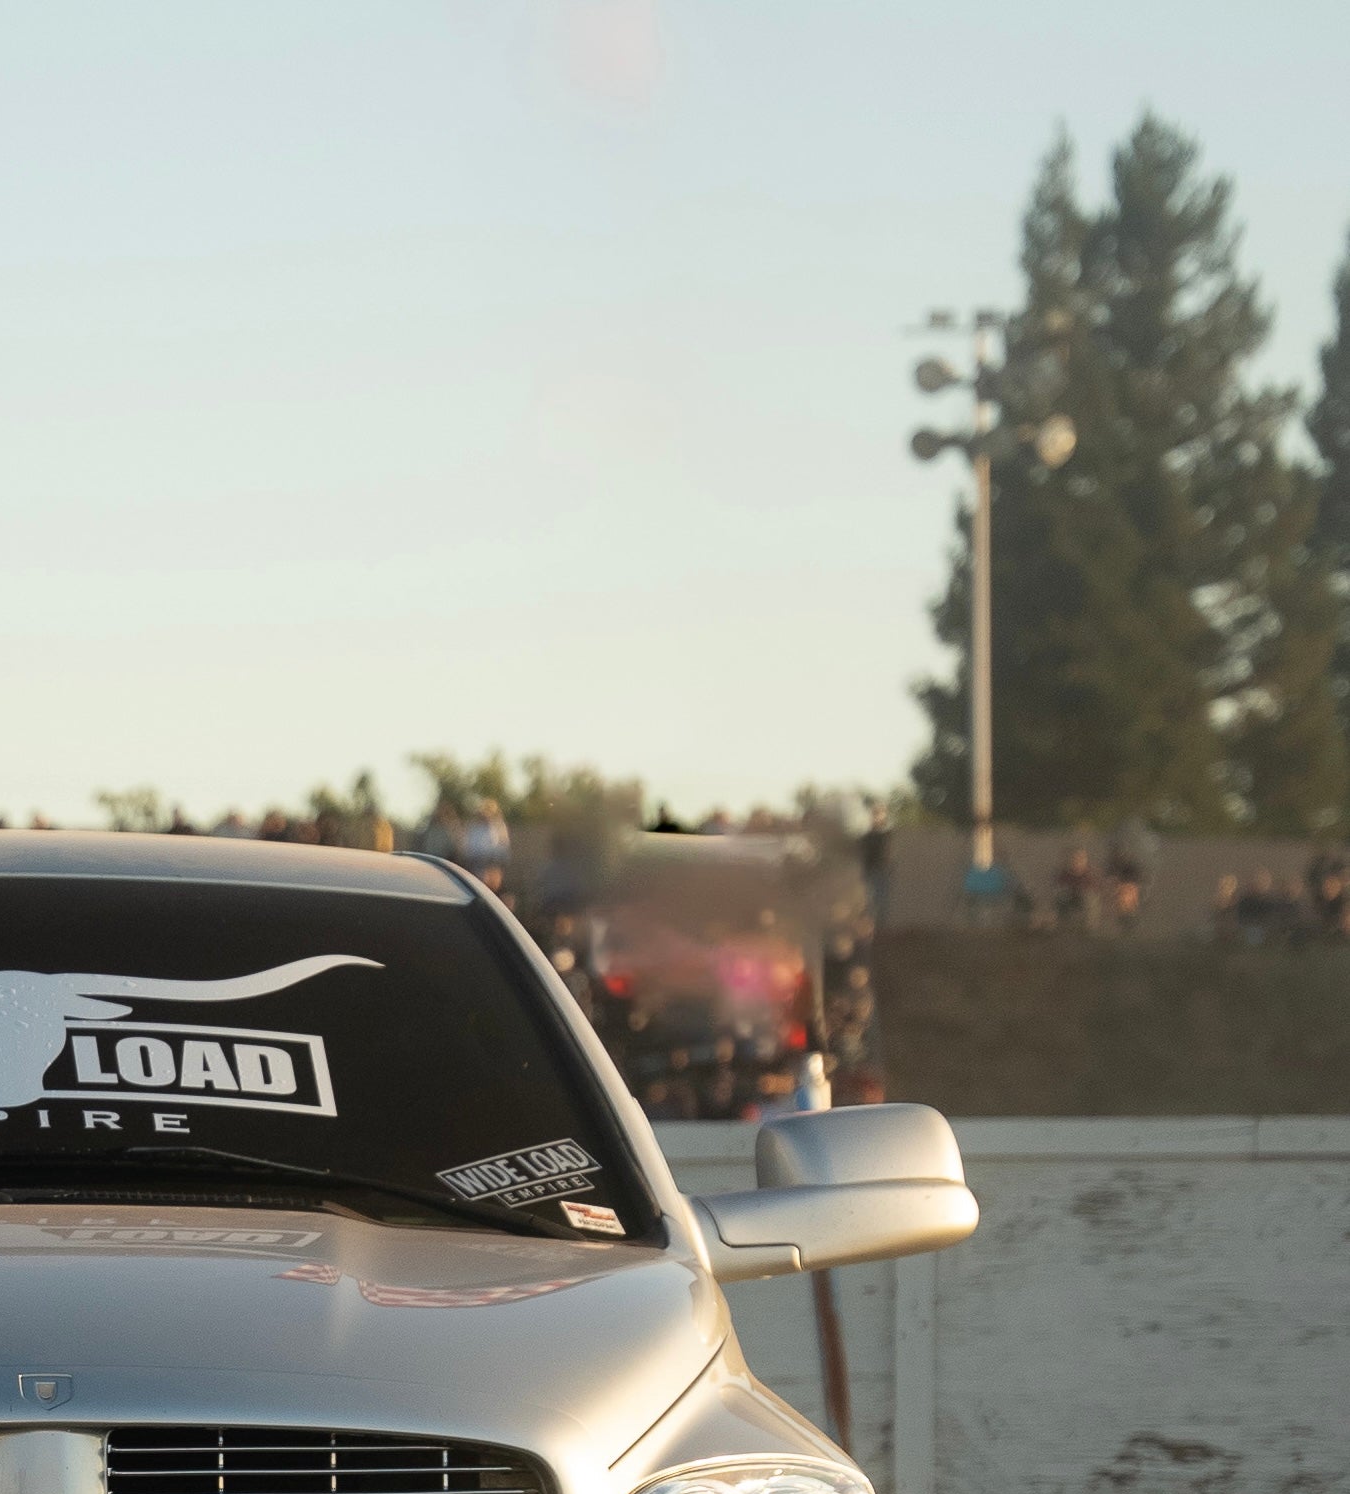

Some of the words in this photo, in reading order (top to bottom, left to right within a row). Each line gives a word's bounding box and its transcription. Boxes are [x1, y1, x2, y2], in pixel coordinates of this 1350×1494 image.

[71, 1035, 297, 1096] LOAD
[446, 1159, 528, 1196] WIDE
[515, 1144, 590, 1178] LOAD
[503, 1176, 585, 1203] EMPIRE
